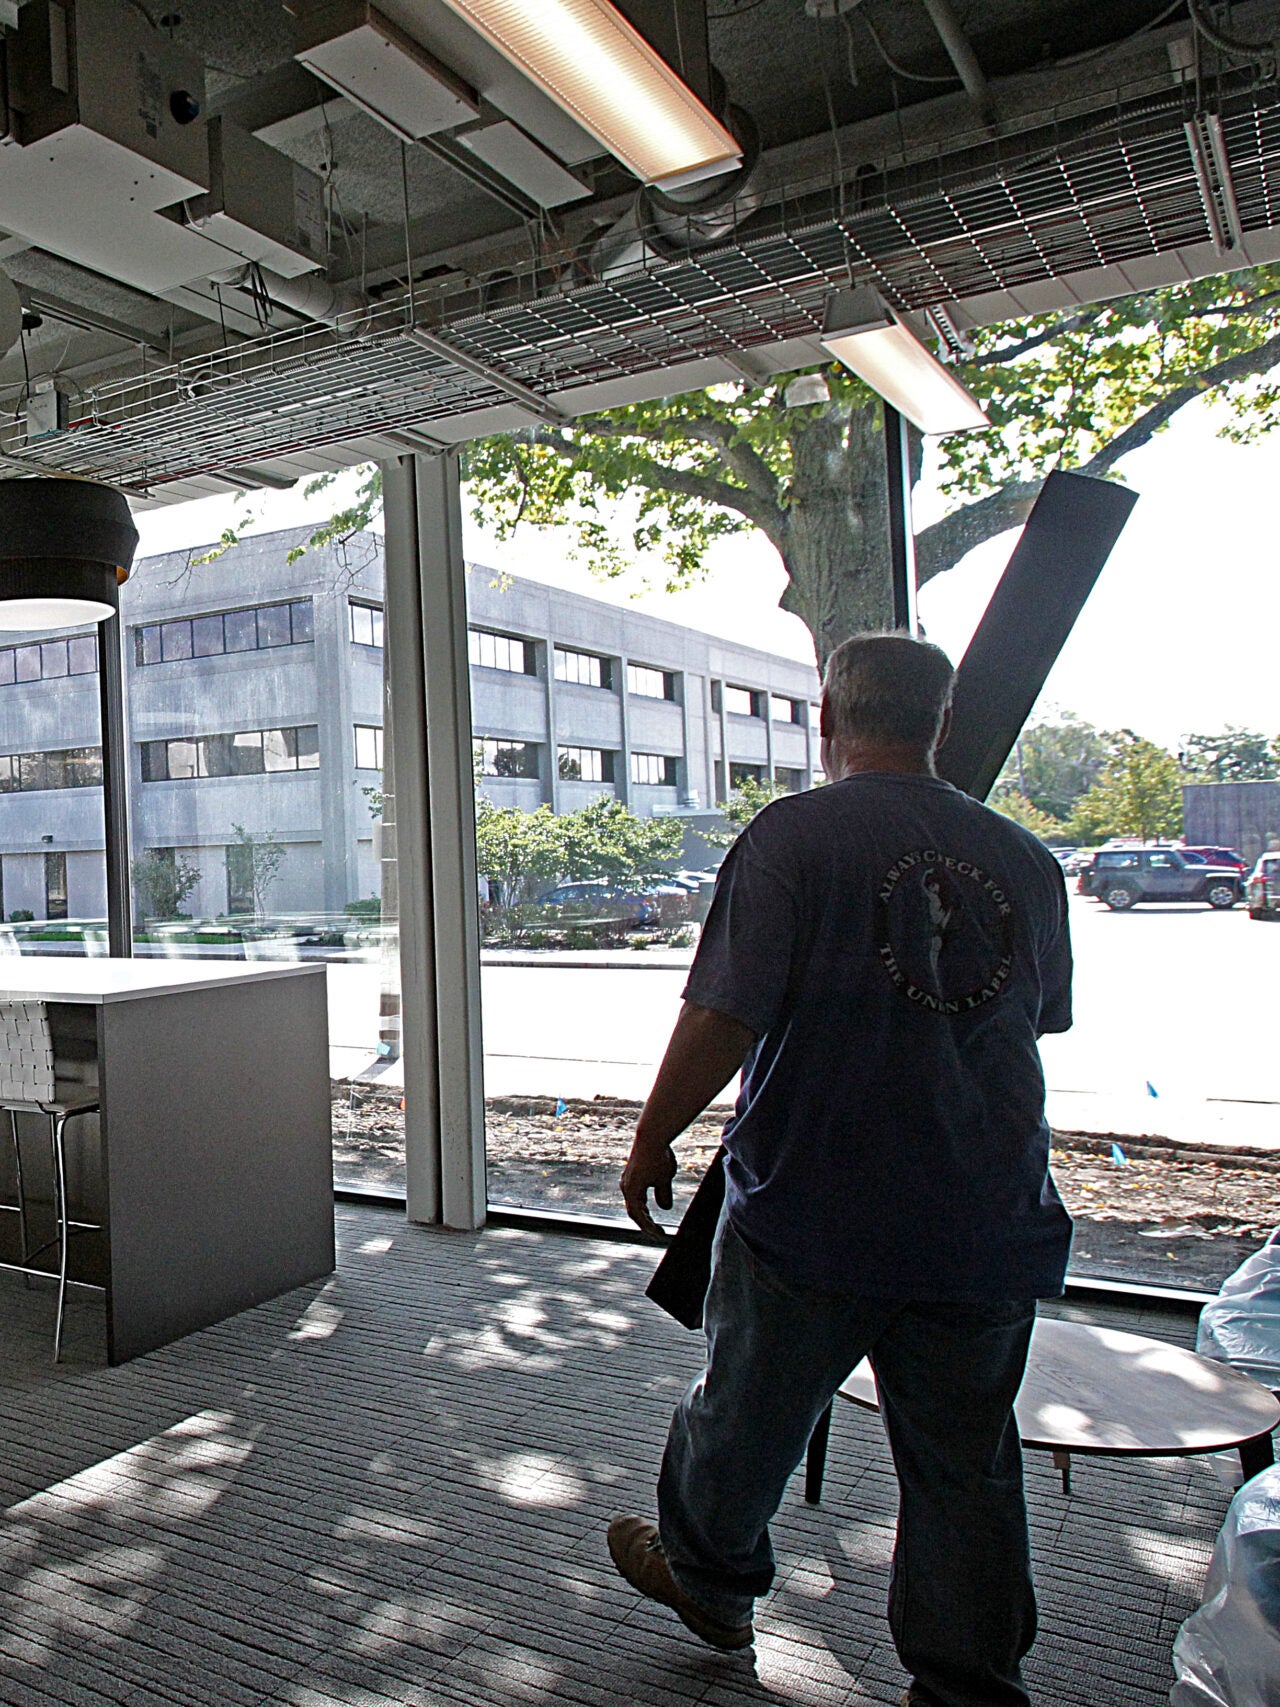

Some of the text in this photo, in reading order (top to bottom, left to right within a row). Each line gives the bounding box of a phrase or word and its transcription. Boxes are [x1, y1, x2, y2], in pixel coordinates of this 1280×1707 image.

[879, 852, 921, 903] ALWAYS
[983, 881, 1011, 916] FOR
[880, 943, 1012, 1013] THE UNIN LABEL
